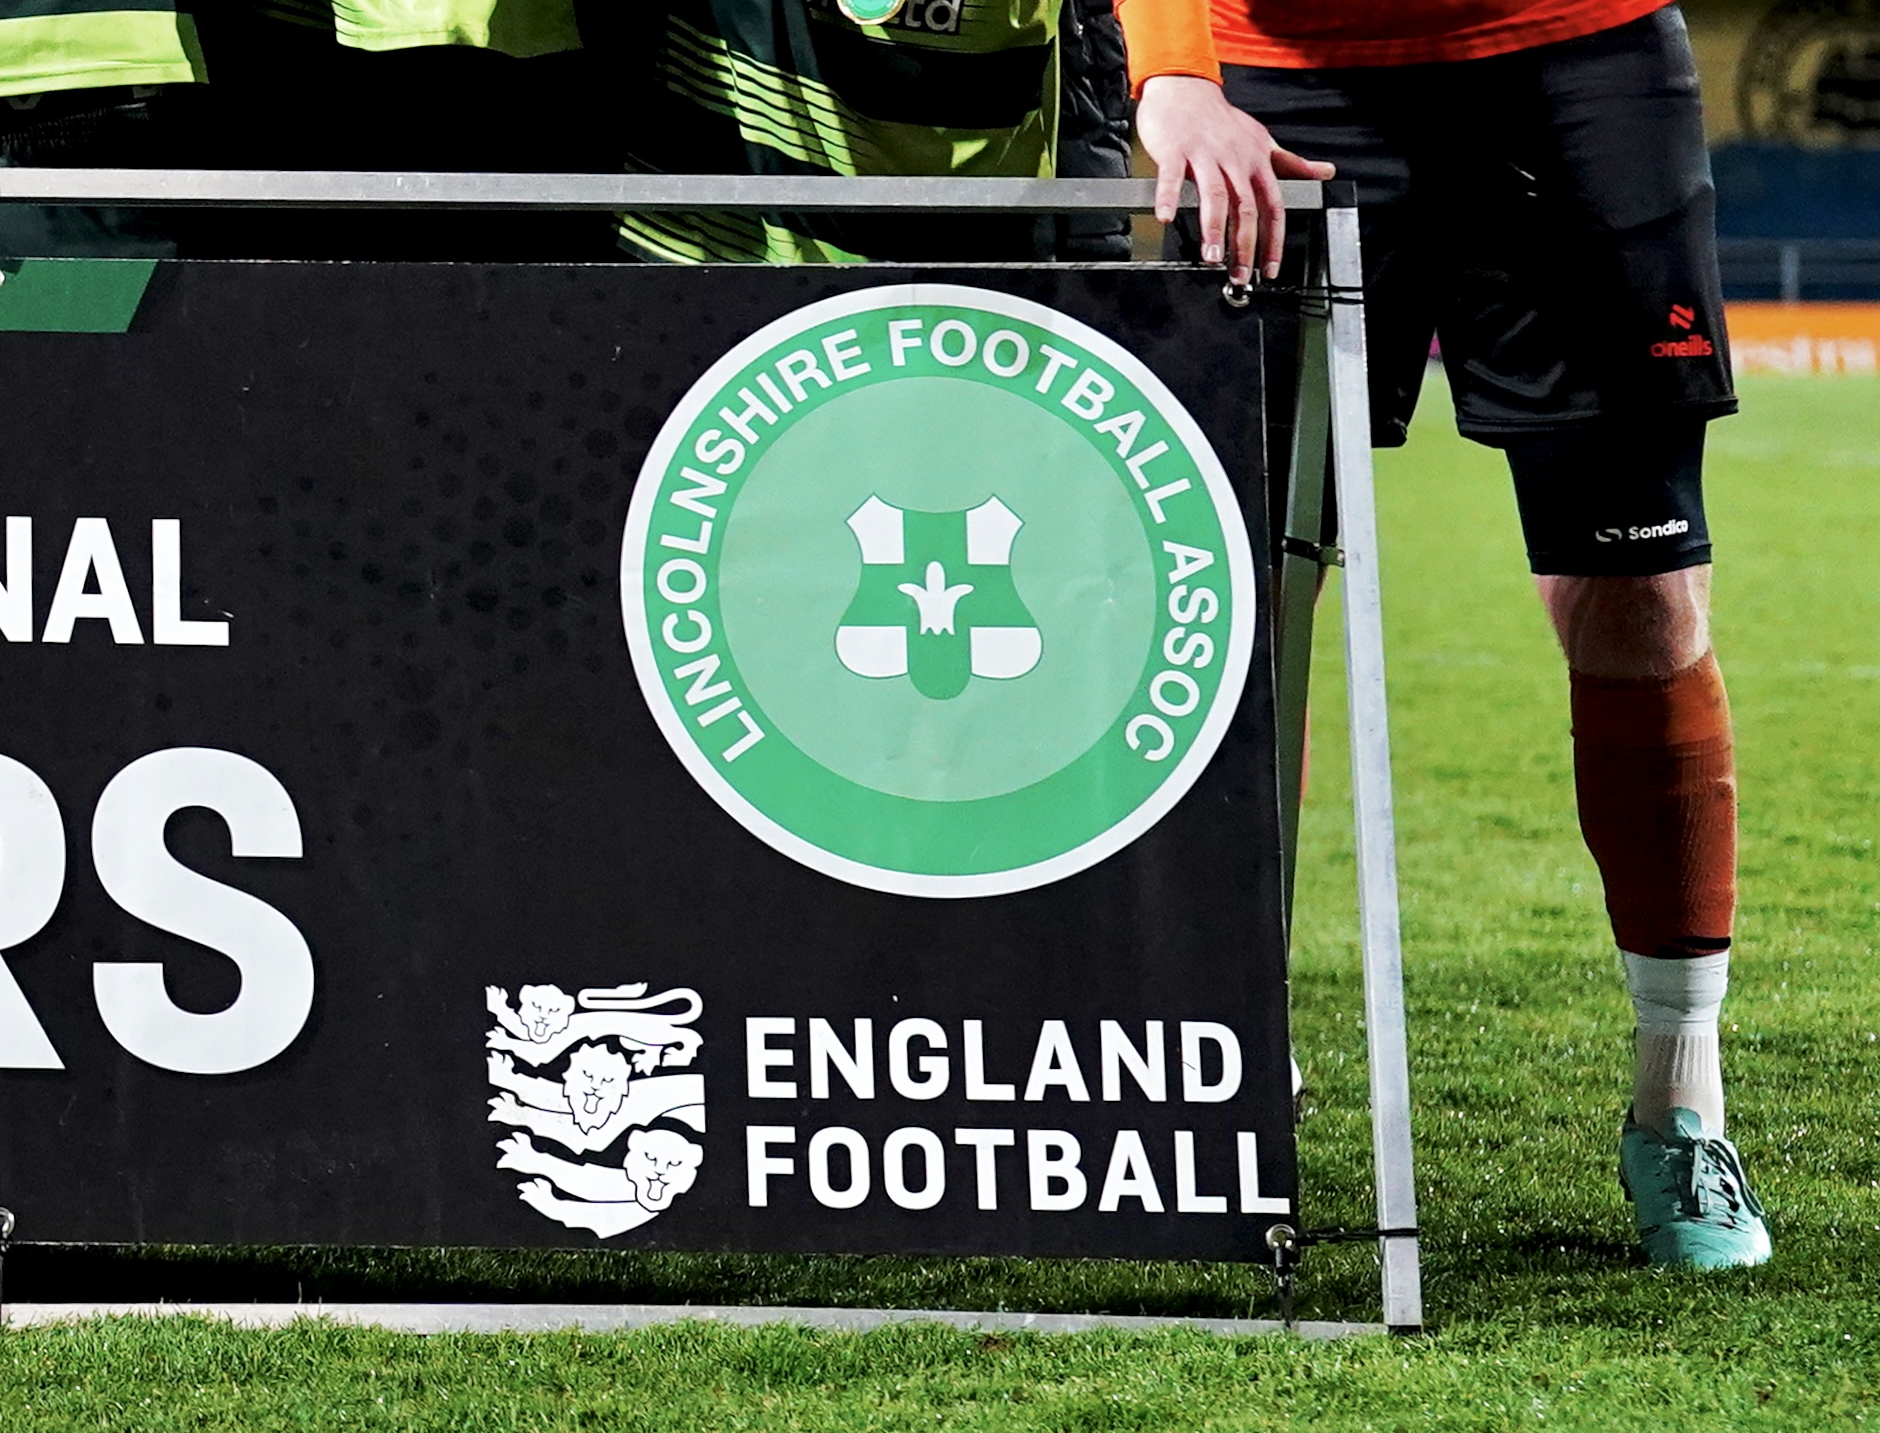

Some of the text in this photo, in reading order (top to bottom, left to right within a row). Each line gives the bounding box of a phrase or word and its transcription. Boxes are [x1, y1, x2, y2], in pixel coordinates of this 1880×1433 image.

[656, 318, 1220, 764] LINCOLNSHIRE FOOTBALL ASSOC
[745, 1016, 1244, 1104] ENGLAND
[745, 1124, 1291, 1215] FOOTBALL
